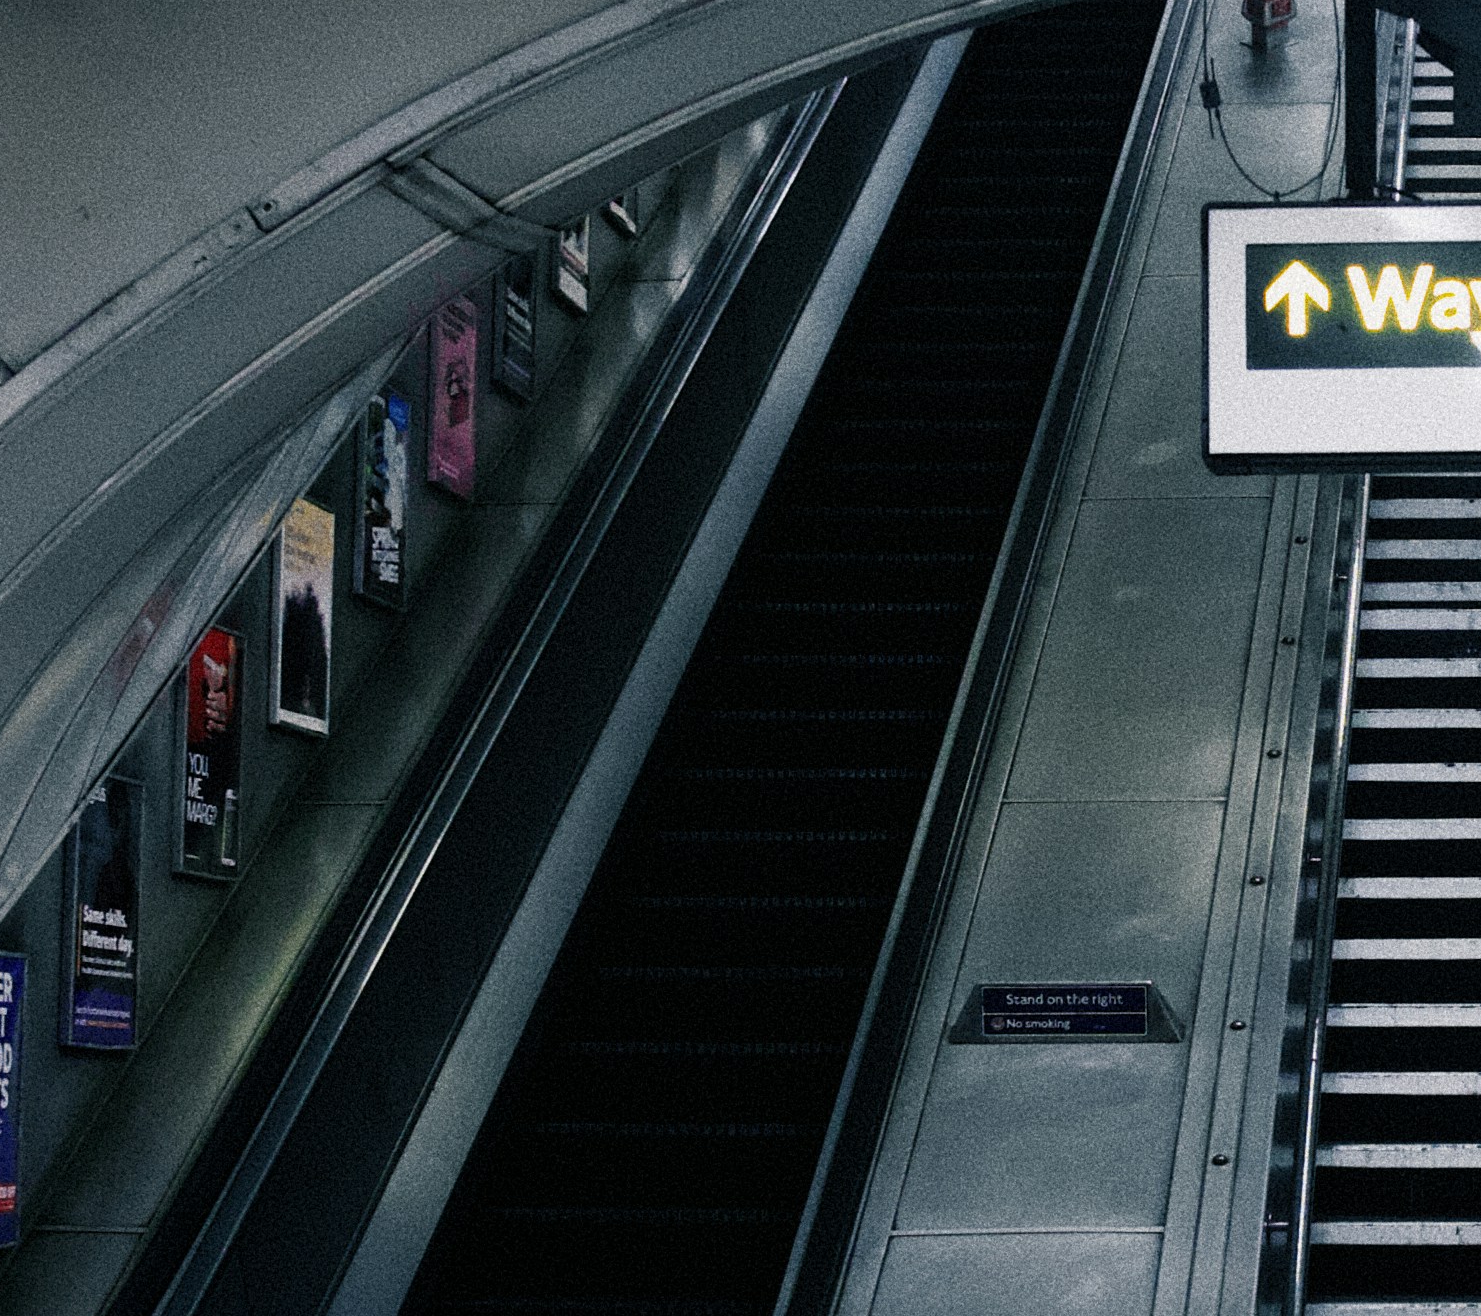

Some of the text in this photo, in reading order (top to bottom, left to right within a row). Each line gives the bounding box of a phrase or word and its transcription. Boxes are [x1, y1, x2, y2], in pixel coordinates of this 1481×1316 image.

[1006, 992, 1124, 1009] Stand on the right
[1006, 1018, 1071, 1032] No smoking
